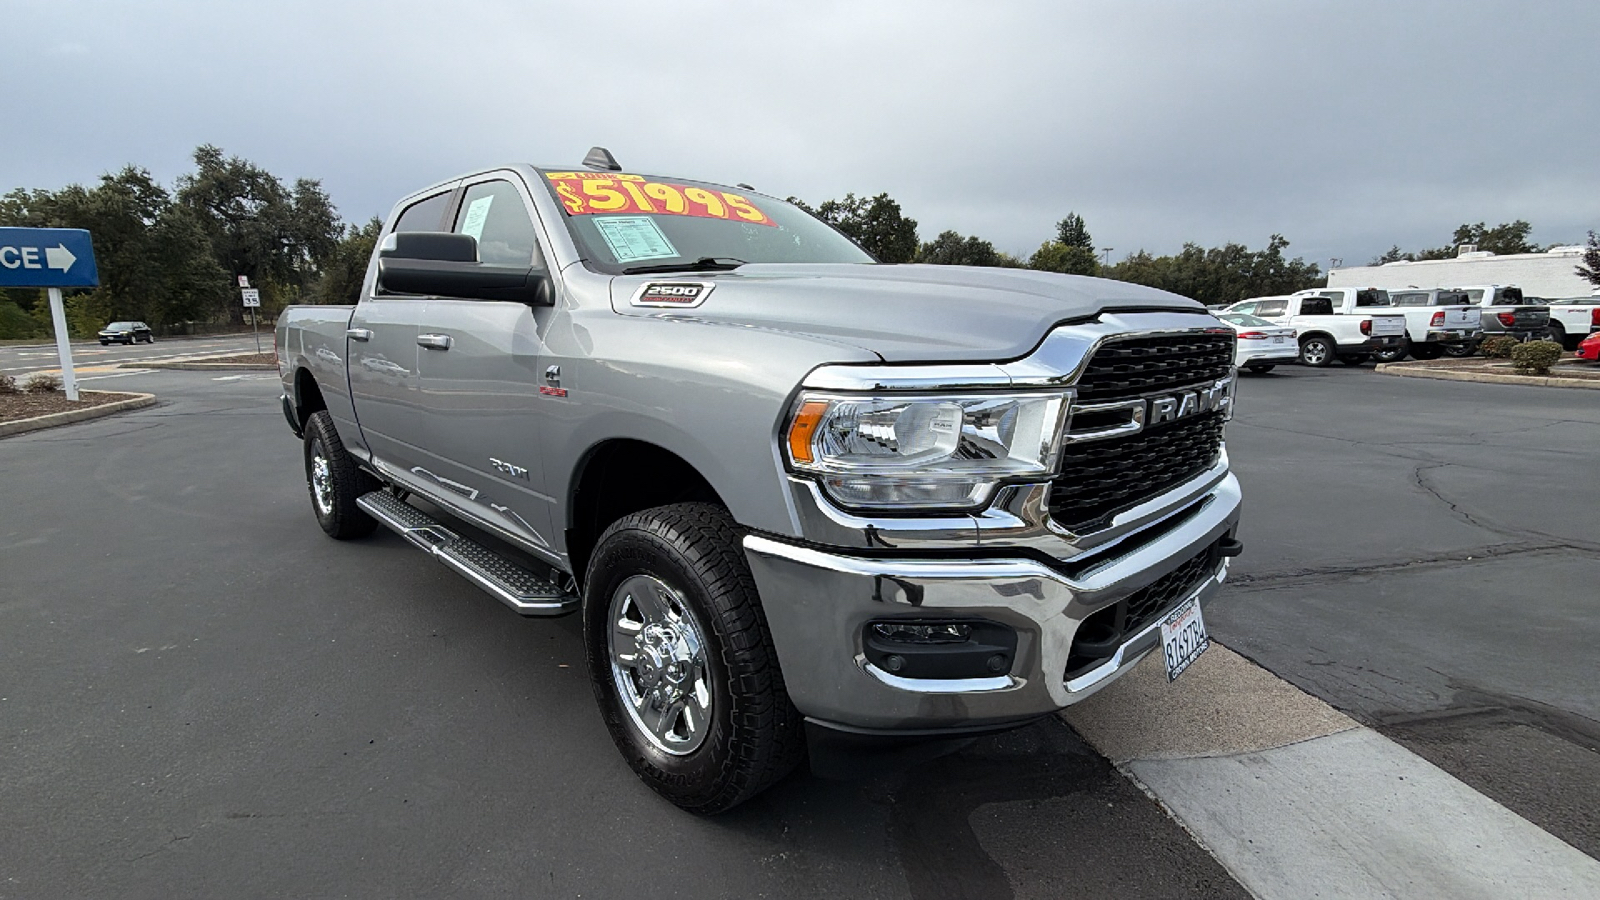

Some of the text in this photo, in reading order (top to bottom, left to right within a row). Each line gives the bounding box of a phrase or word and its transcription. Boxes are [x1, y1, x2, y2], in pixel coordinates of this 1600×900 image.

[556, 179, 768, 223] $51995
[245, 297, 259, 305] 35
[647, 286, 698, 296] 2500
[1151, 387, 1222, 424] RAM
